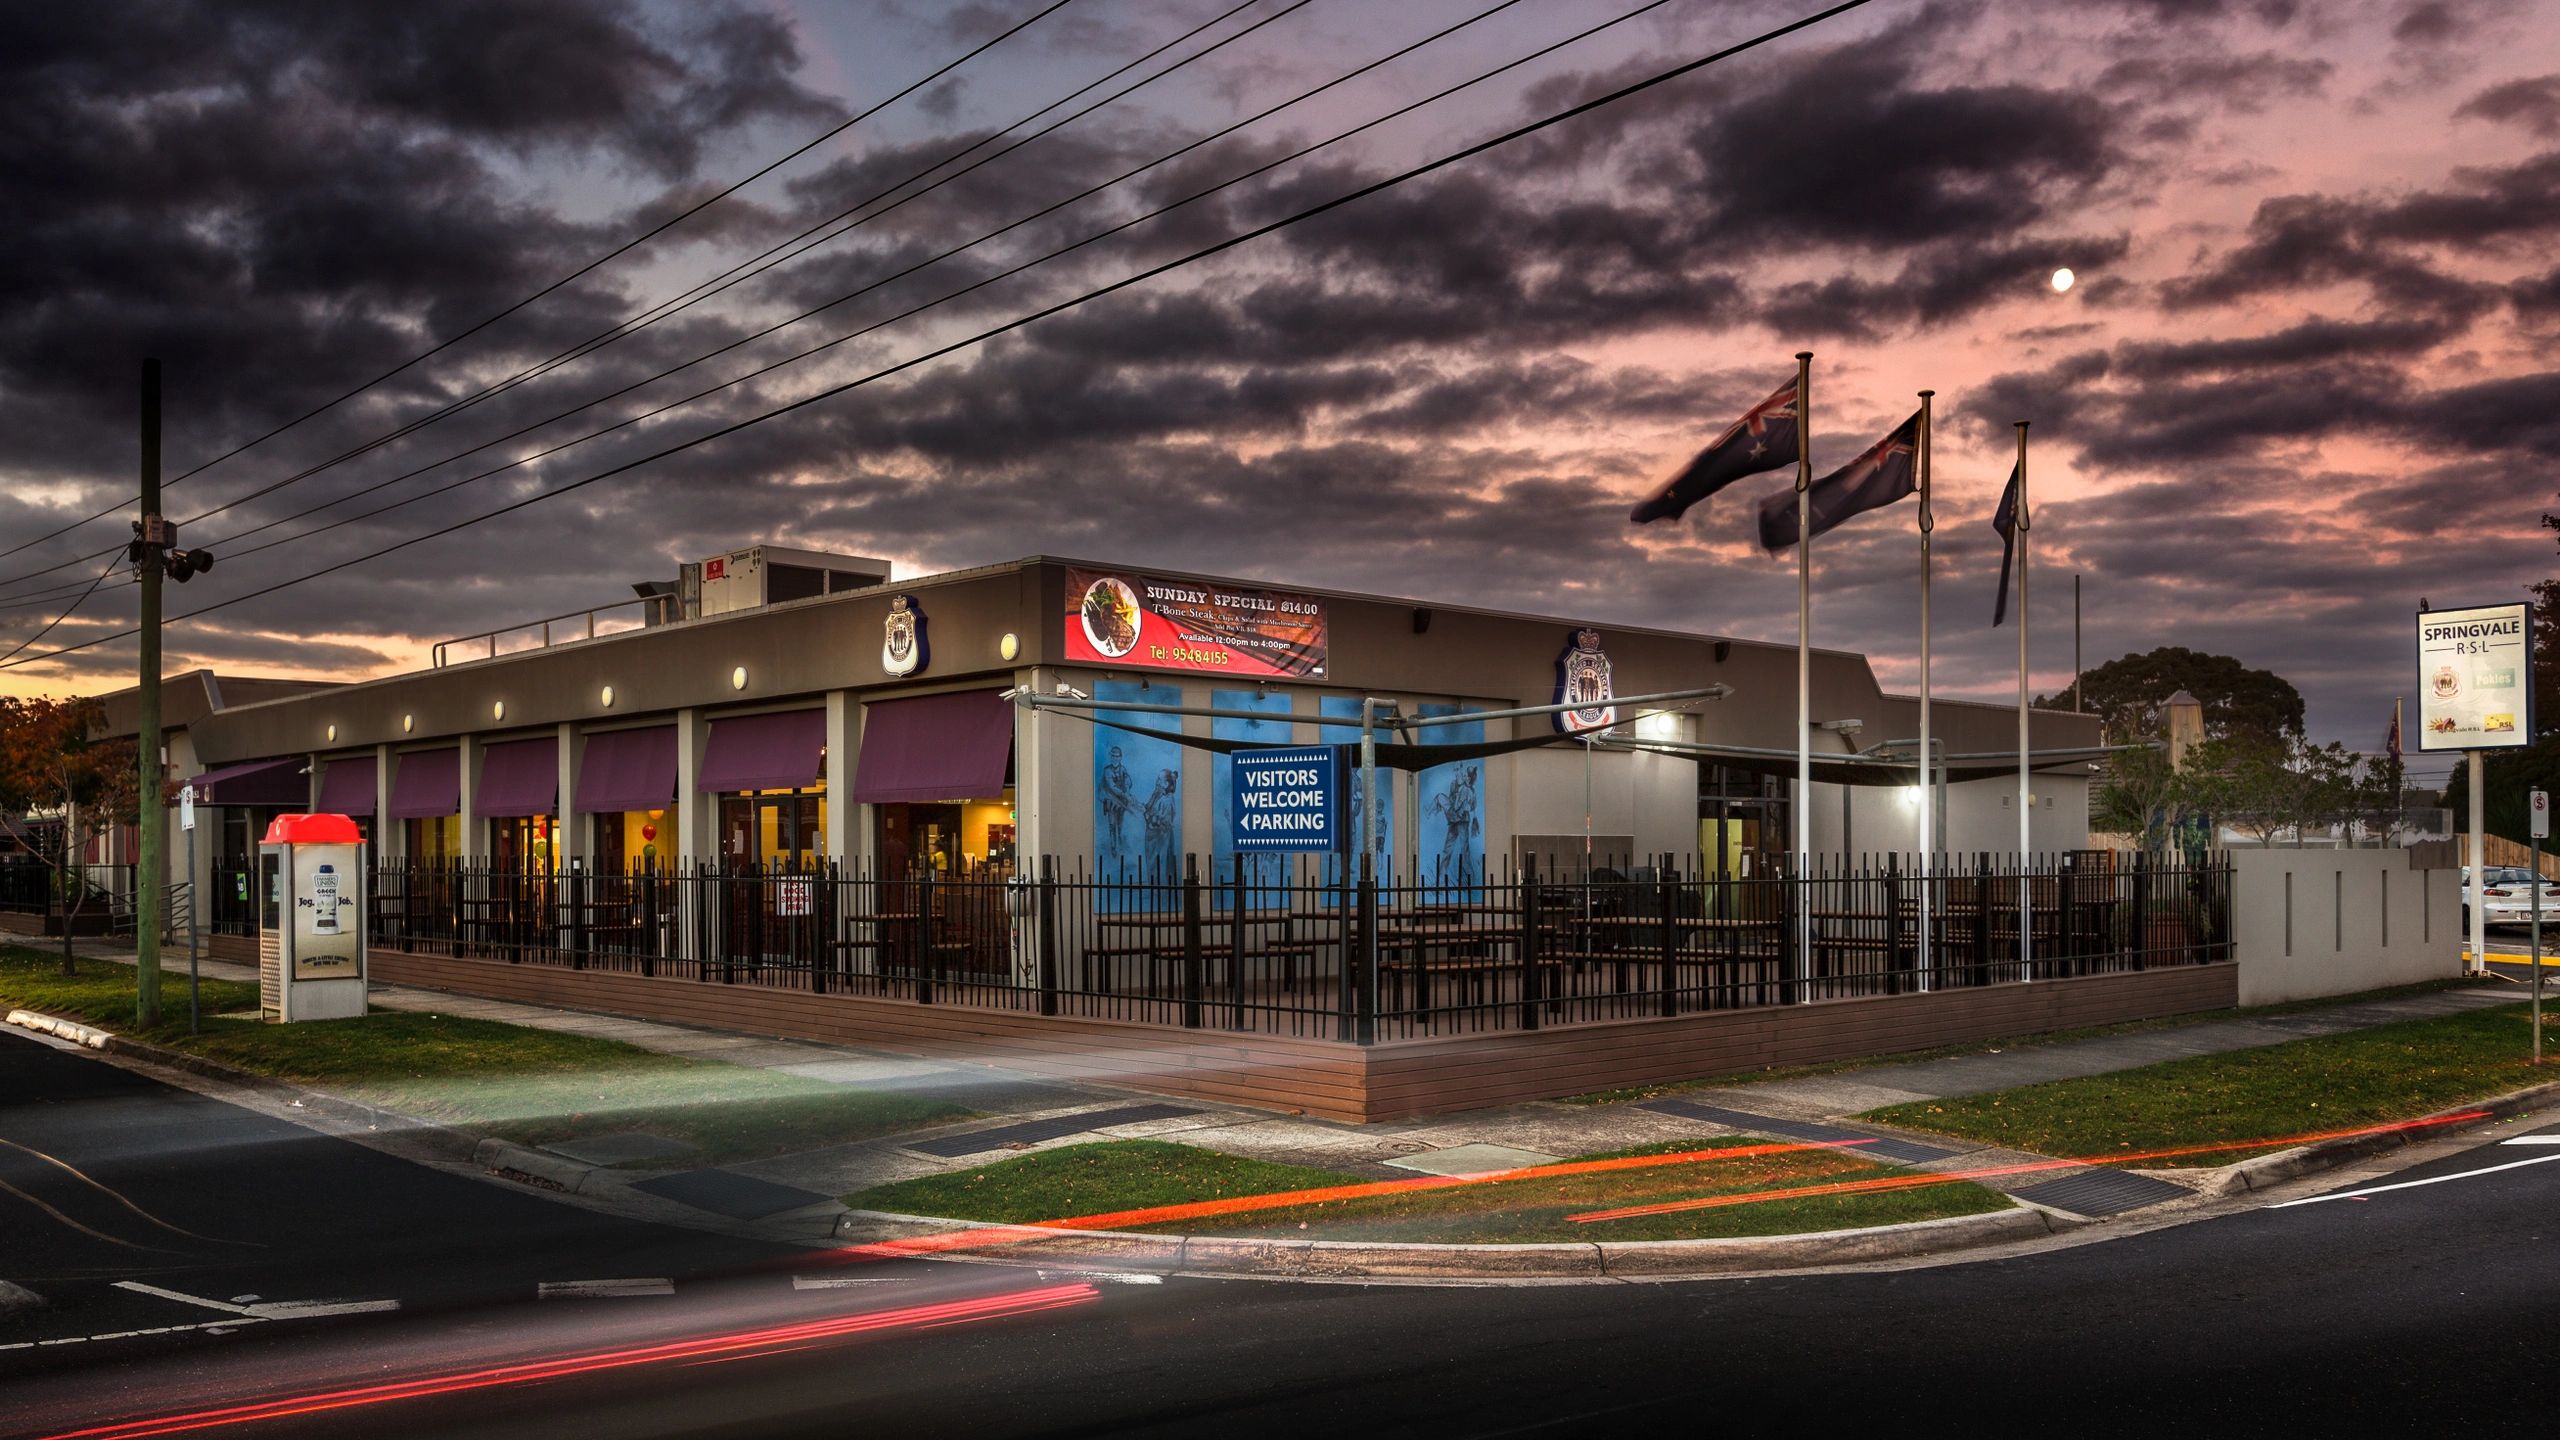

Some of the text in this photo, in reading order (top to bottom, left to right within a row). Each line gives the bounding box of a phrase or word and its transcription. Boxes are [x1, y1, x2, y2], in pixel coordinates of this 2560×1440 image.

[1147, 587, 1318, 615] SUNDAY SPECIAL $14.00
[1152, 603, 1186, 617] T-Bone
[2424, 621, 2520, 641] SPRINGVALE
[1178, 632, 1291, 650] Available 12:00pm to 4:00pm
[1150, 645, 1229, 665] Tel: 95484155
[1245, 769, 1318, 787] VISITORS
[1241, 790, 1324, 808] WELCOME
[1252, 813, 1325, 830] PARKING
[298, 897, 353, 907] Jog. Job.
